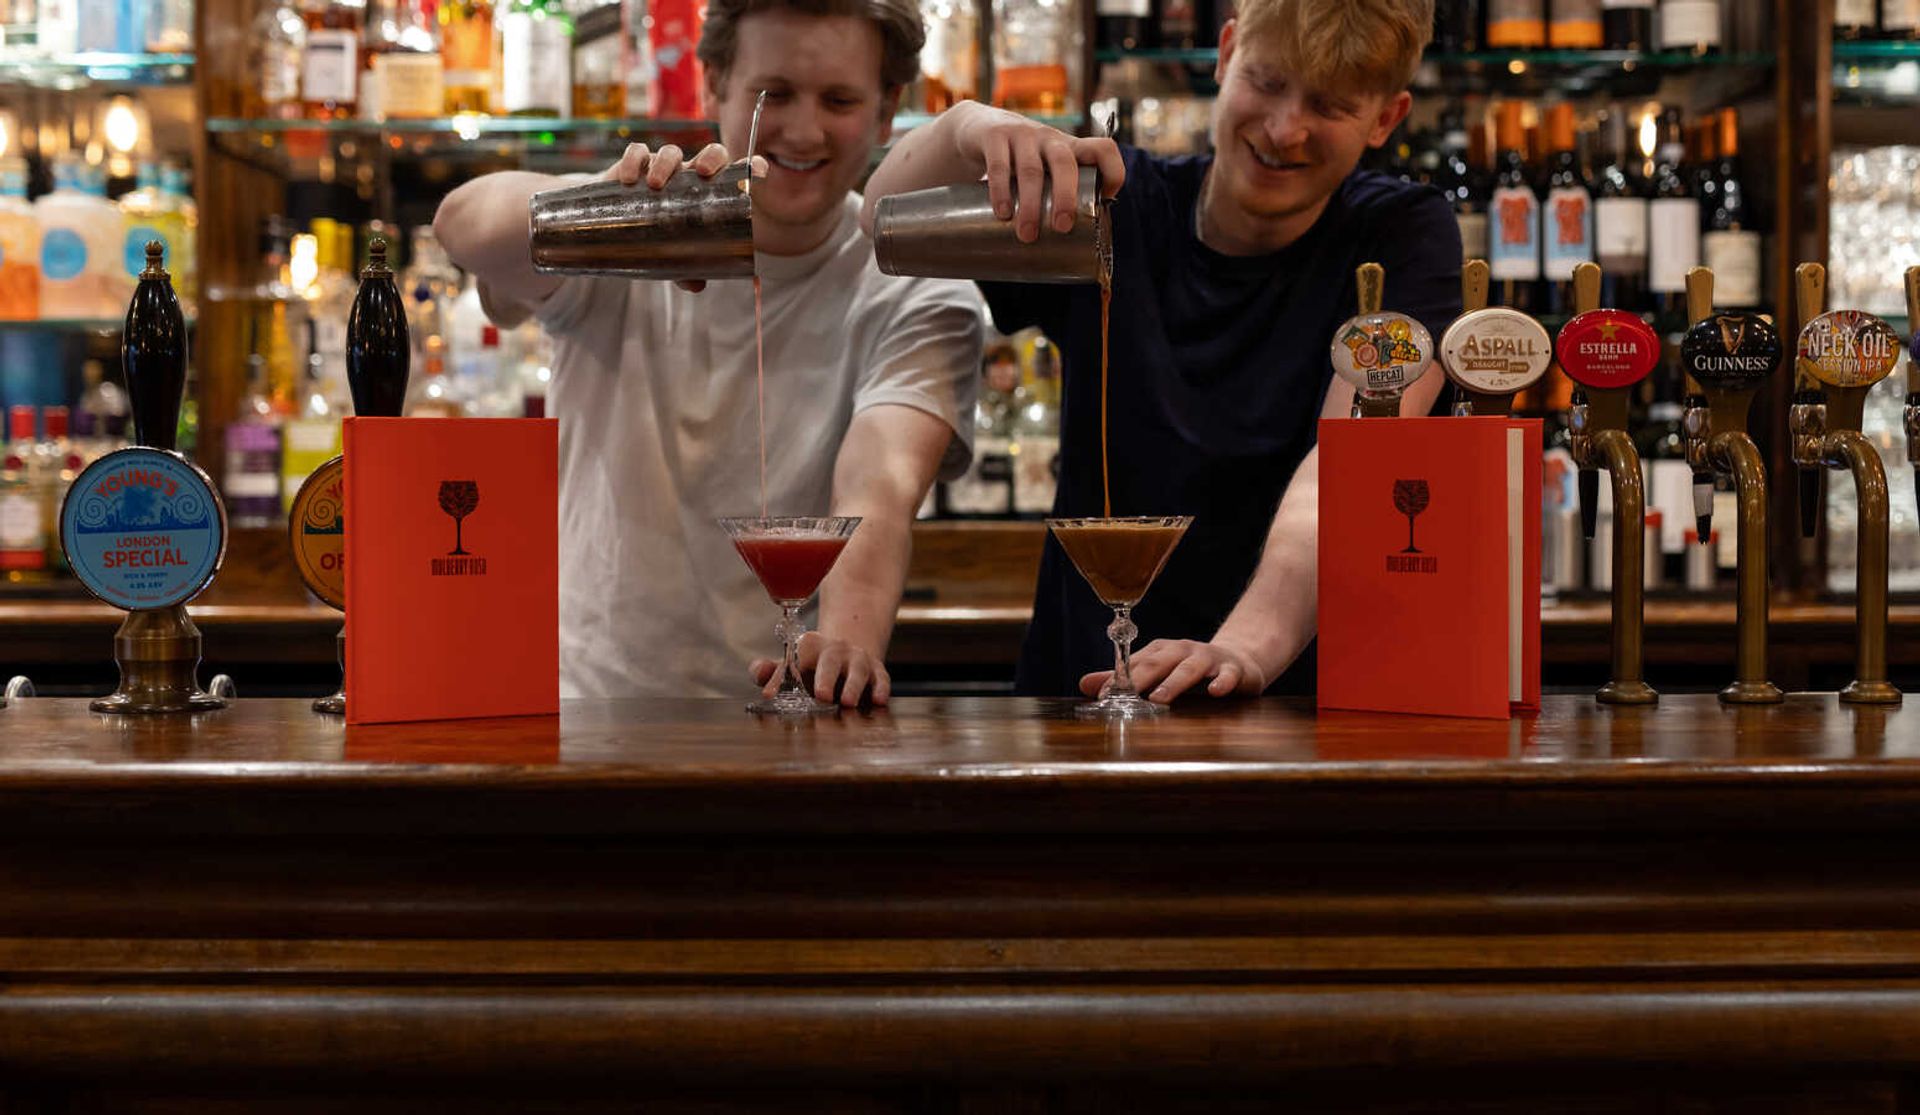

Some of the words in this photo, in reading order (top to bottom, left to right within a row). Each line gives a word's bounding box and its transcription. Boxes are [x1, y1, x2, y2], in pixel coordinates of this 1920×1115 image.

[1463, 334, 1537, 356] ASPALL
[1579, 342, 1638, 354] ESTRELLA
[1807, 331, 1858, 358] NECK
[1862, 332, 1892, 358] OIL
[1694, 354, 1770, 371] GUINNESS
[1370, 369, 1401, 382] HEPCAT
[93, 468, 179, 497] YOUNG'S
[116, 535, 171, 548] LONDON
[103, 549, 188, 568] SPECIAL
